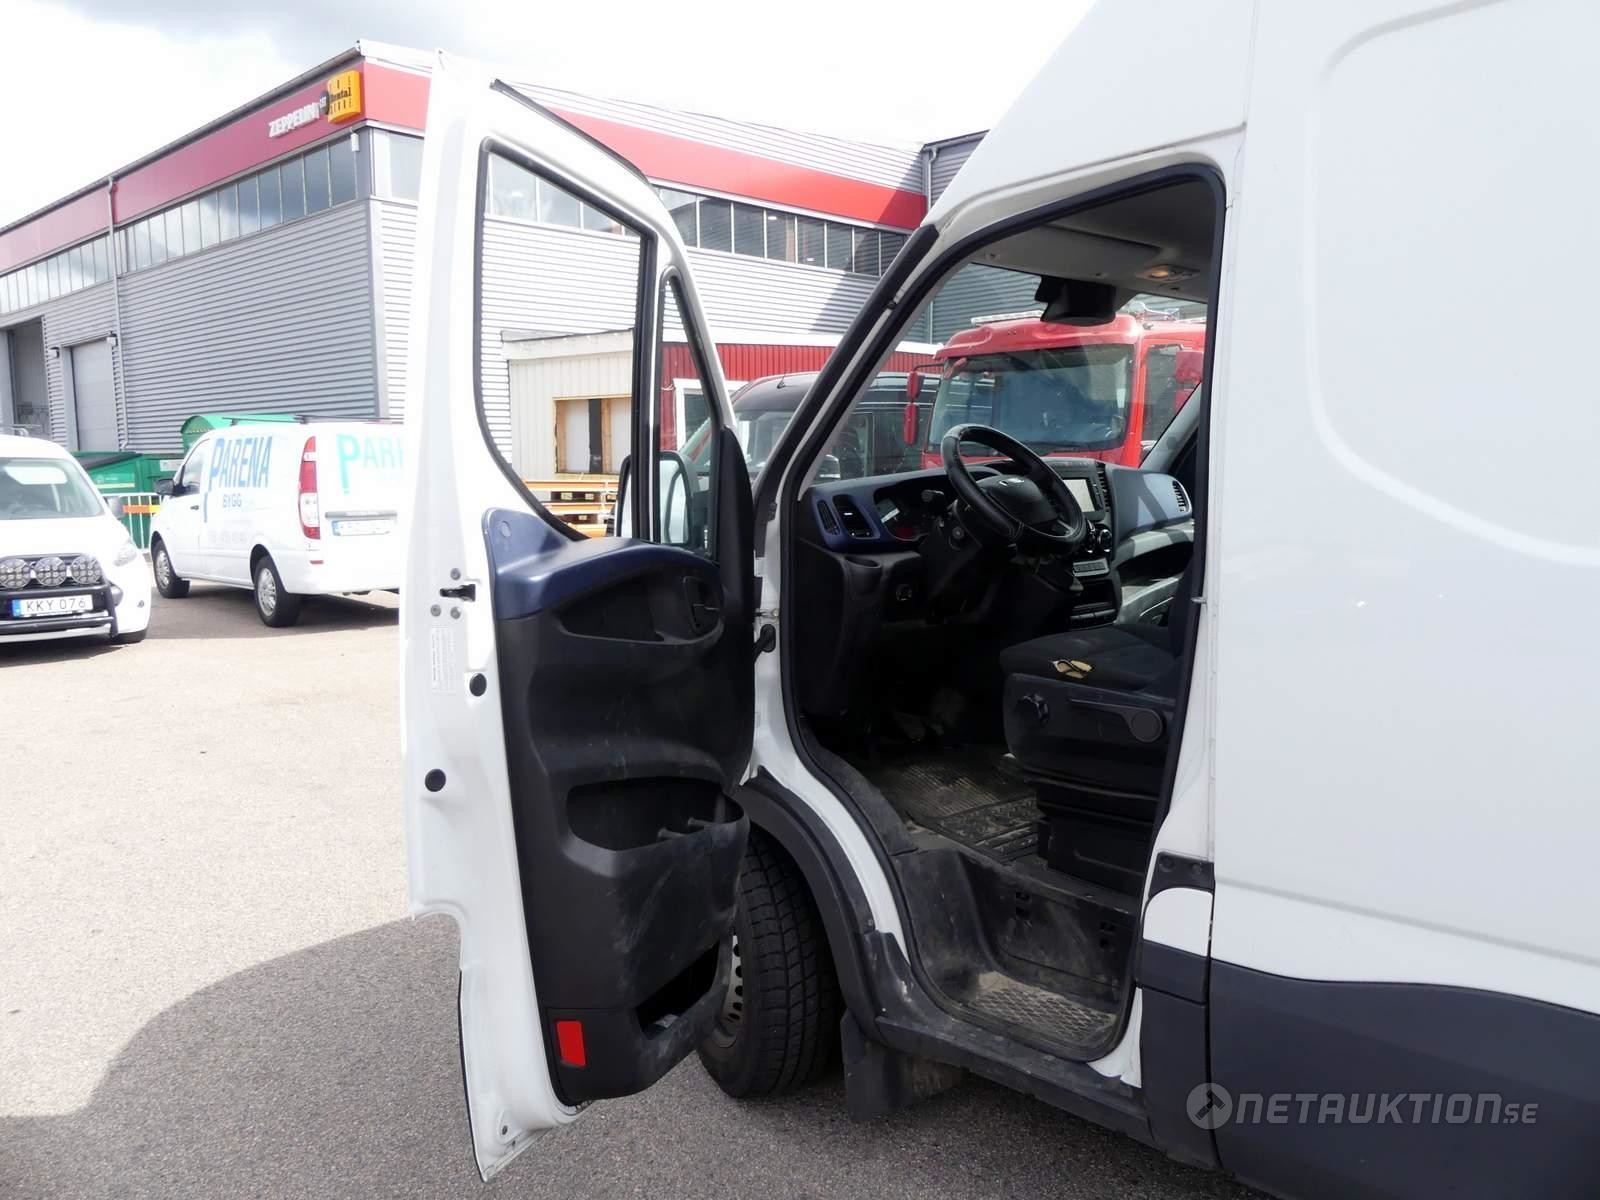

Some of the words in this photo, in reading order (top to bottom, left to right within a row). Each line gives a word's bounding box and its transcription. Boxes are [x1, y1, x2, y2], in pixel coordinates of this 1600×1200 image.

[204, 436, 273, 523] PARENA
[222, 493, 243, 508] BYGG
[26, 600, 54, 613] KKY
[59, 598, 86, 610] 076
